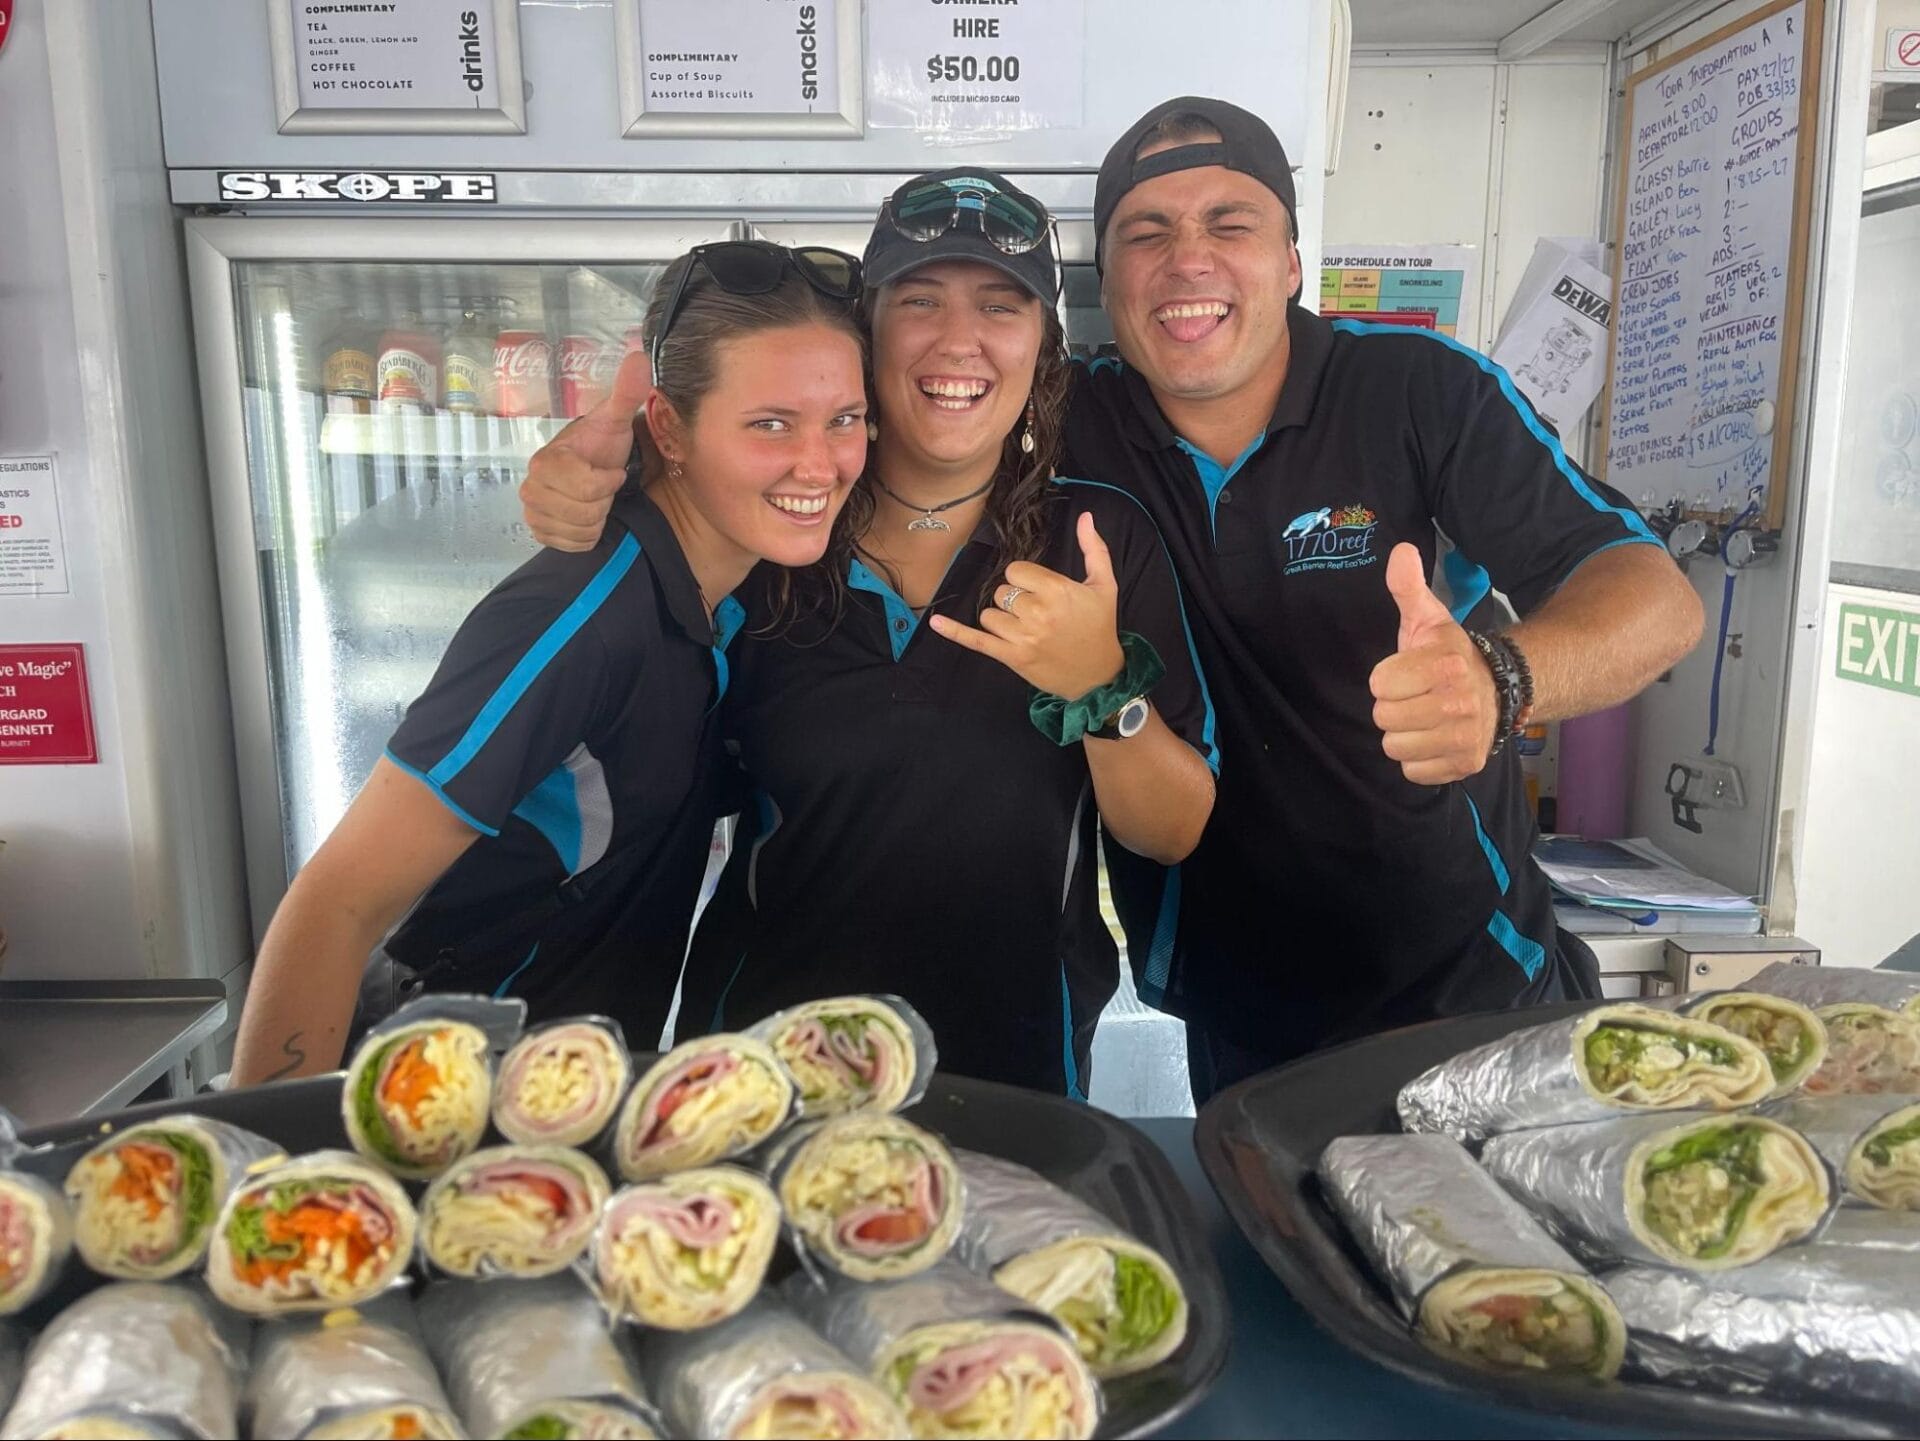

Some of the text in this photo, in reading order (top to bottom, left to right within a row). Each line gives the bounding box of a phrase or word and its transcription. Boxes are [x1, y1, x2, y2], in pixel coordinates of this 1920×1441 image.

[306, 4, 396, 14] COMPLIMENTARY
[307, 23, 328, 31] TEA
[953, 18, 999, 38] HIRE
[1762, 28, 1771, 47] A
[1785, 17, 1795, 36] R
[459, 11, 484, 91] drinks
[648, 54, 738, 62] COMPLIMENTARY
[796, 5, 817, 100] snacks
[311, 63, 356, 72] COFFEE
[650, 72, 722, 82] Cup of Soup
[927, 54, 1020, 83] $50.00
[1656, 42, 1757, 99] TOUR INFORMATION
[1737, 66, 1760, 90] PAX
[313, 80, 413, 90] HOT CHOCOLATE
[651, 90, 754, 99] Assorted Biscuits
[1737, 83, 1763, 107] POB
[931, 95, 965, 103] INCLUDES
[1001, 95, 1020, 103] CARD
[1638, 110, 1679, 143] ARRIVAL
[1732, 108, 1783, 146] GROUPS
[221, 172, 495, 201] SKOPE
[1635, 165, 1673, 195] GLASSY
[1630, 186, 1673, 217] ISLAND
[1629, 207, 1669, 240] GALLEY
[1624, 241, 1646, 261] BACK
[1650, 225, 1675, 249] DECK
[1344, 257, 1392, 267] SCHEDULE
[1393, 258, 1408, 268] ON
[1409, 258, 1433, 268] TOUR
[1628, 254, 1660, 278] FLOAT
[1714, 259, 1761, 288] PLATTERS
[1552, 277, 1612, 328] DEWA
[1621, 280, 1649, 303] CREW
[1697, 315, 1777, 351] MAINTENANCE
